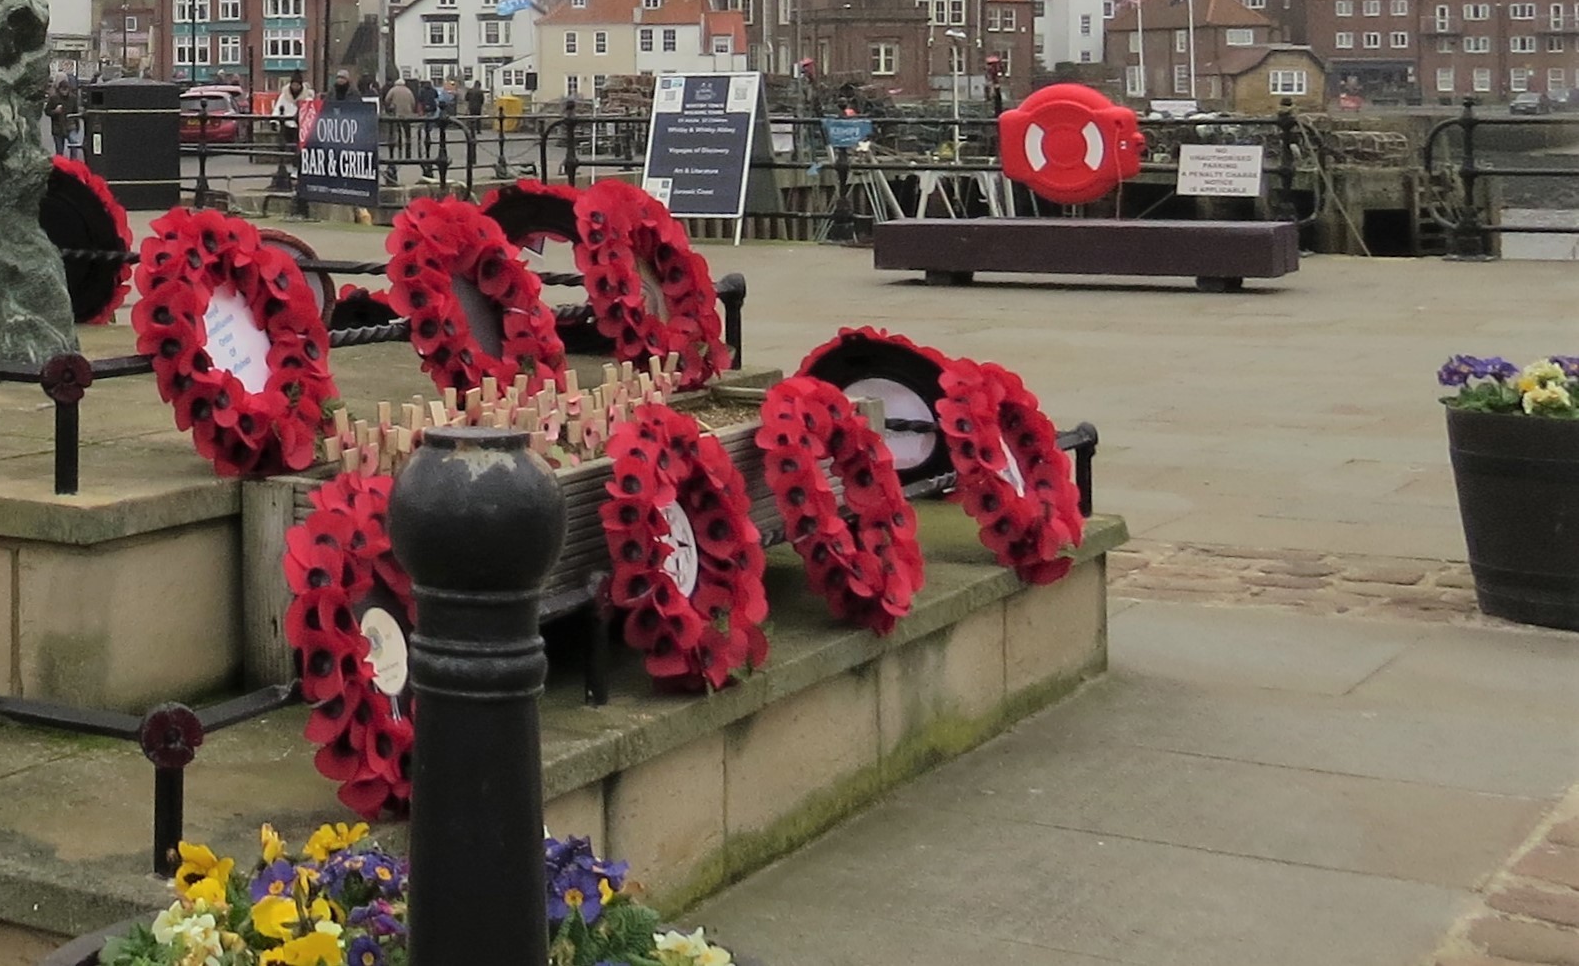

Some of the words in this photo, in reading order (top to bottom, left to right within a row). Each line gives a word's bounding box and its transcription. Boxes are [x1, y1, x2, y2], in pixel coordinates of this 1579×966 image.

[316, 118, 358, 144] ORLOP
[701, 147, 730, 155] Discovery
[301, 148, 326, 176] BAR
[327, 148, 338, 177] &
[339, 149, 377, 180] GRILL
[1199, 186, 1247, 194] APPLICABLE
